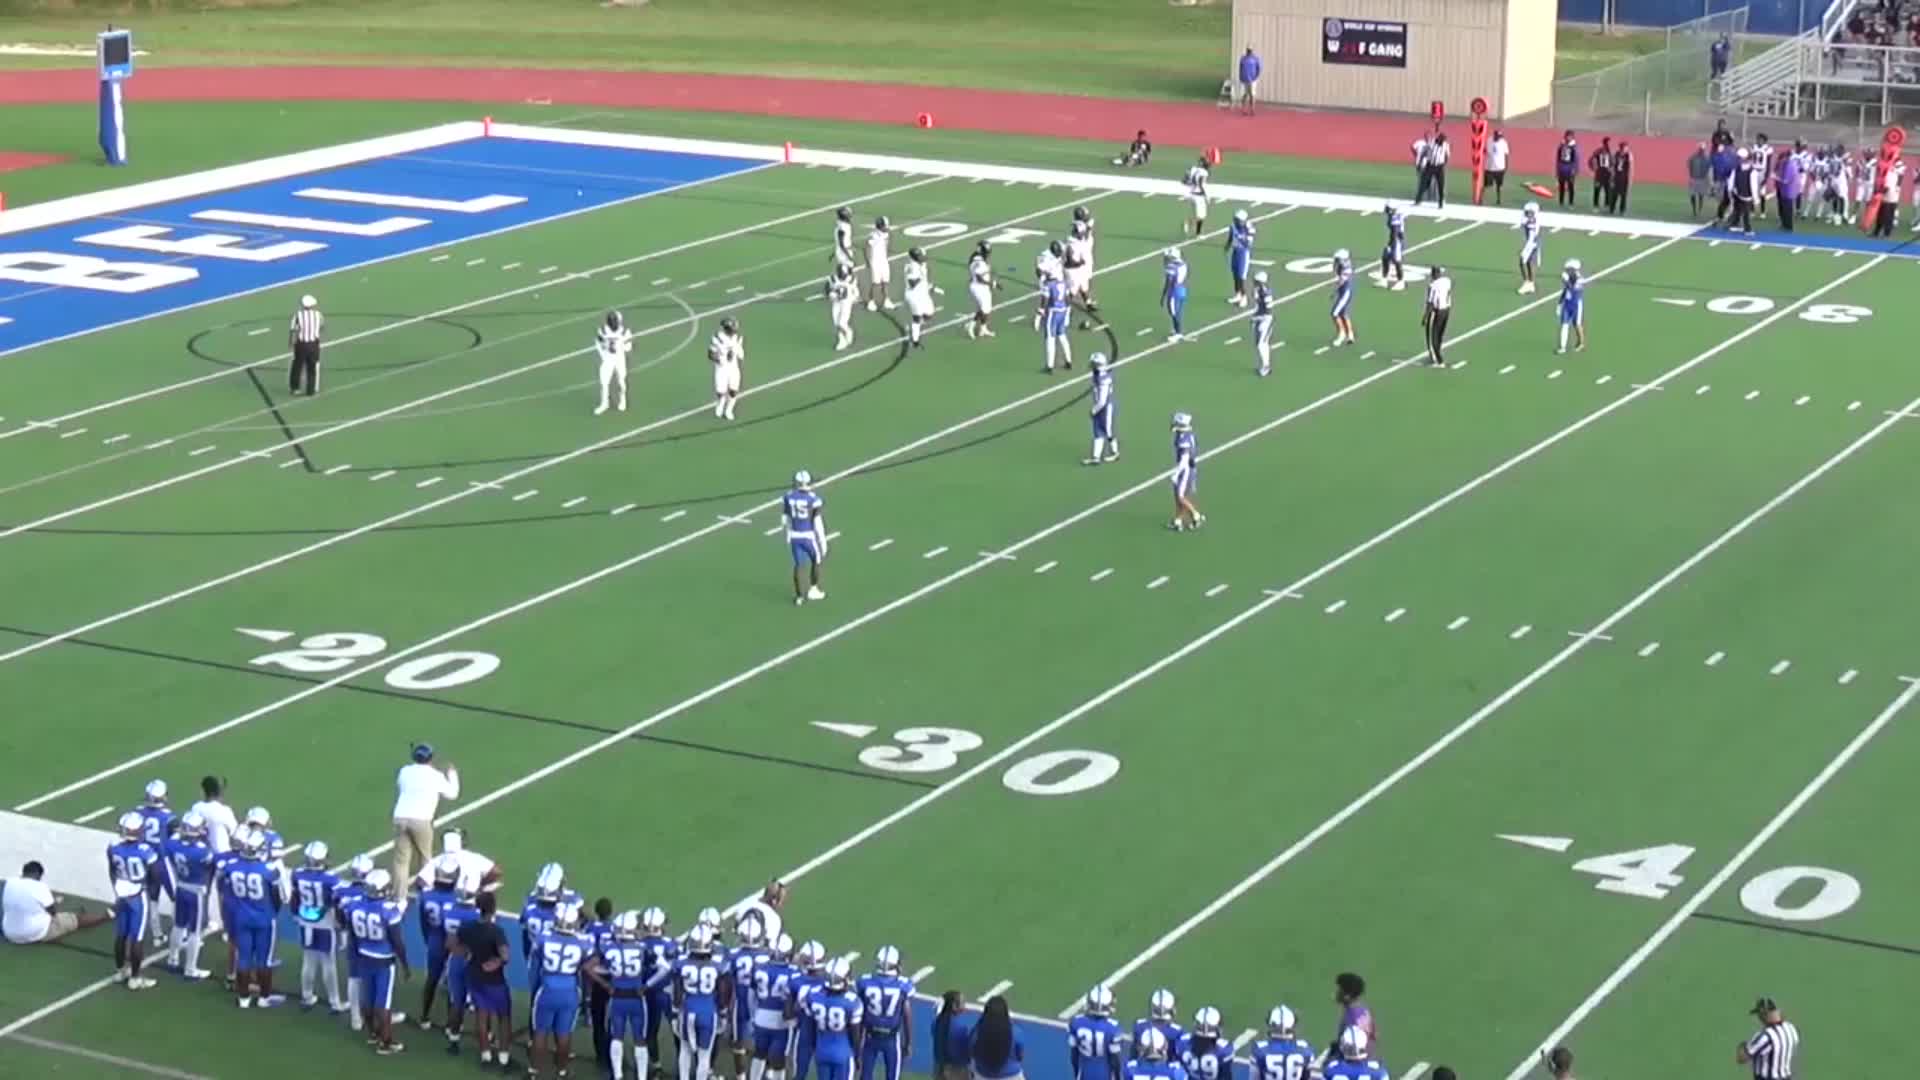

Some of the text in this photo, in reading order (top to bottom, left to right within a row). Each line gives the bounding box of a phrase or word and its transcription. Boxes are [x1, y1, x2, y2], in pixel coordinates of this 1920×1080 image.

[0, 187, 528, 325] BELL
[788, 498, 809, 519] 15
[248, 632, 501, 689] 20
[858, 726, 1121, 795] 30
[111, 854, 147, 881] 30
[1571, 842, 1861, 921] 40
[230, 870, 264, 900] 69
[297, 878, 324, 908] 51
[351, 908, 385, 941] 66
[543, 940, 582, 975] 52
[605, 948, 642, 977] 35
[681, 964, 719, 995] 28
[754, 969, 792, 1000] 34
[811, 1001, 847, 1032] 38
[865, 986, 901, 1018] 37
[1076, 1027, 1105, 1058] 31
[1264, 1053, 1305, 1080] 56
